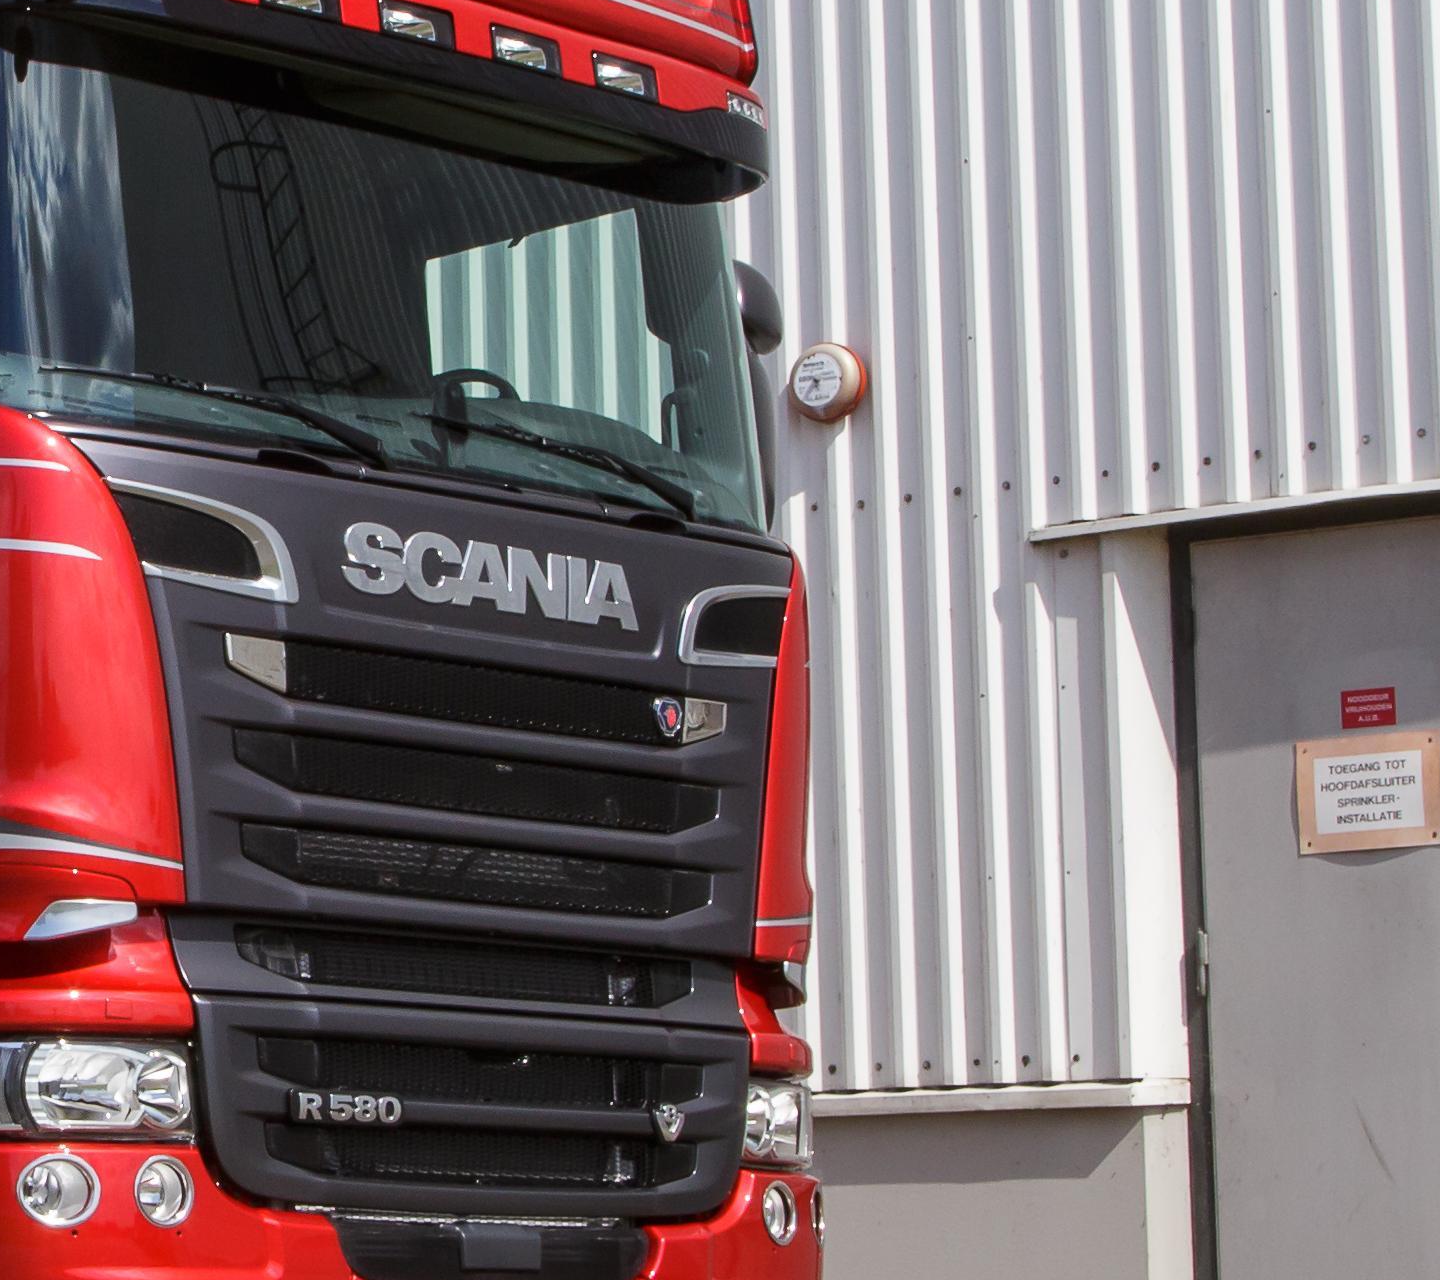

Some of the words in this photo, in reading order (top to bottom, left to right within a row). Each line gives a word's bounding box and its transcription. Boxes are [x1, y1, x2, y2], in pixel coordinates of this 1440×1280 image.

[340, 521, 639, 631] SCANIA
[1328, 761, 1381, 776] TOEGANG
[1385, 758, 1407, 771] TOT
[1320, 775, 1417, 793] HOOFDAFSLUITER
[1336, 810, 1403, 825] INSTALLATIE
[298, 1092, 323, 1120] R
[329, 1093, 402, 1124] 580
